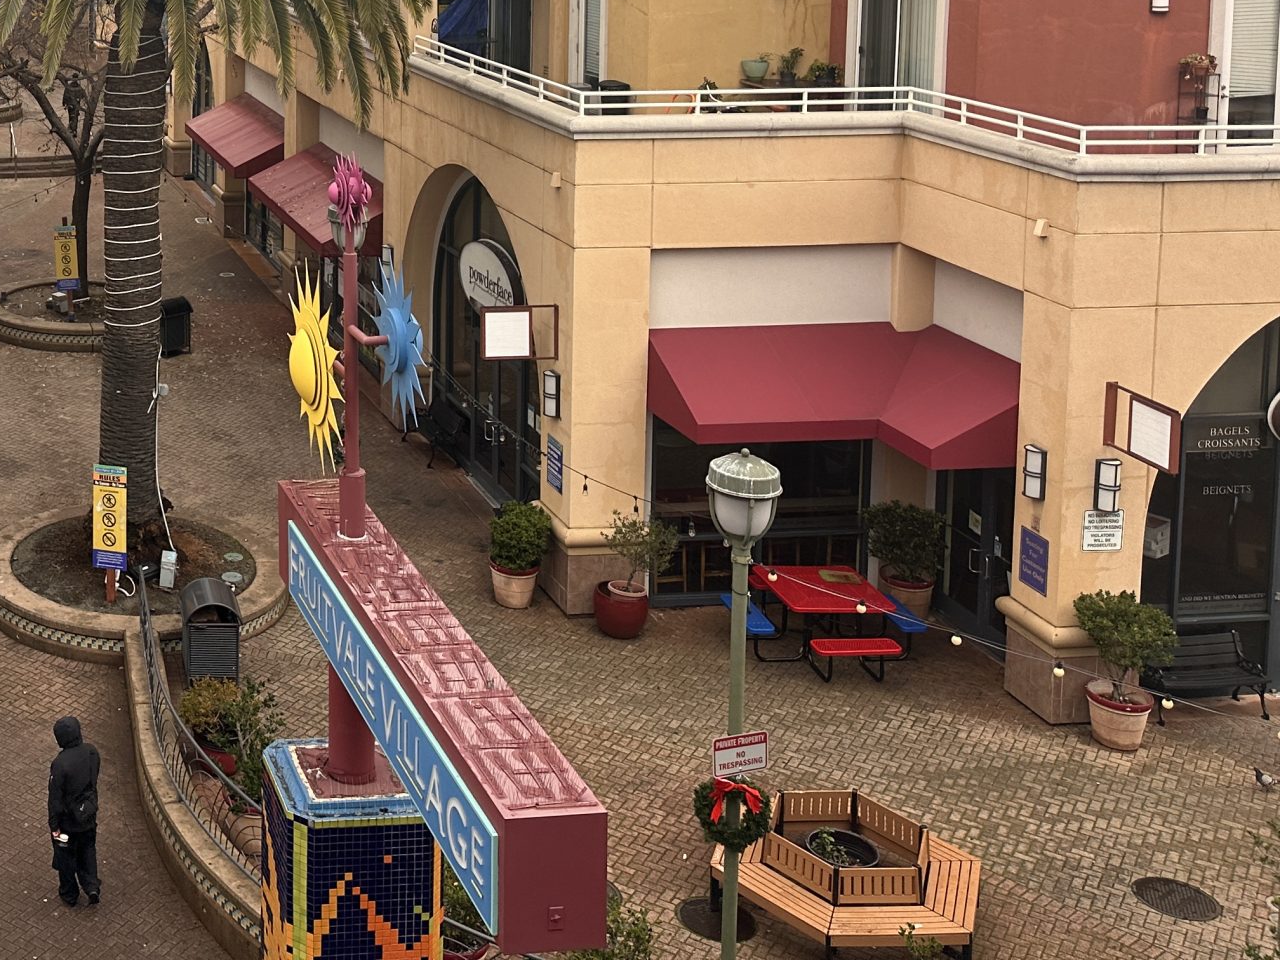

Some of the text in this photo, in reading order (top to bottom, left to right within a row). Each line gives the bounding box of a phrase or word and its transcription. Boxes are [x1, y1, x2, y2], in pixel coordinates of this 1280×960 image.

[469, 265, 512, 304] powderface
[1210, 426, 1250, 436] BAGELS
[1198, 438, 1260, 448] CROISSANTS
[1202, 484, 1252, 495] BEIGNETS
[290, 540, 484, 886] FRUITVALE VILLAGE
[716, 735, 764, 749] PRIVATE PROPERTY
[719, 757, 763, 770] TRESPASSING
